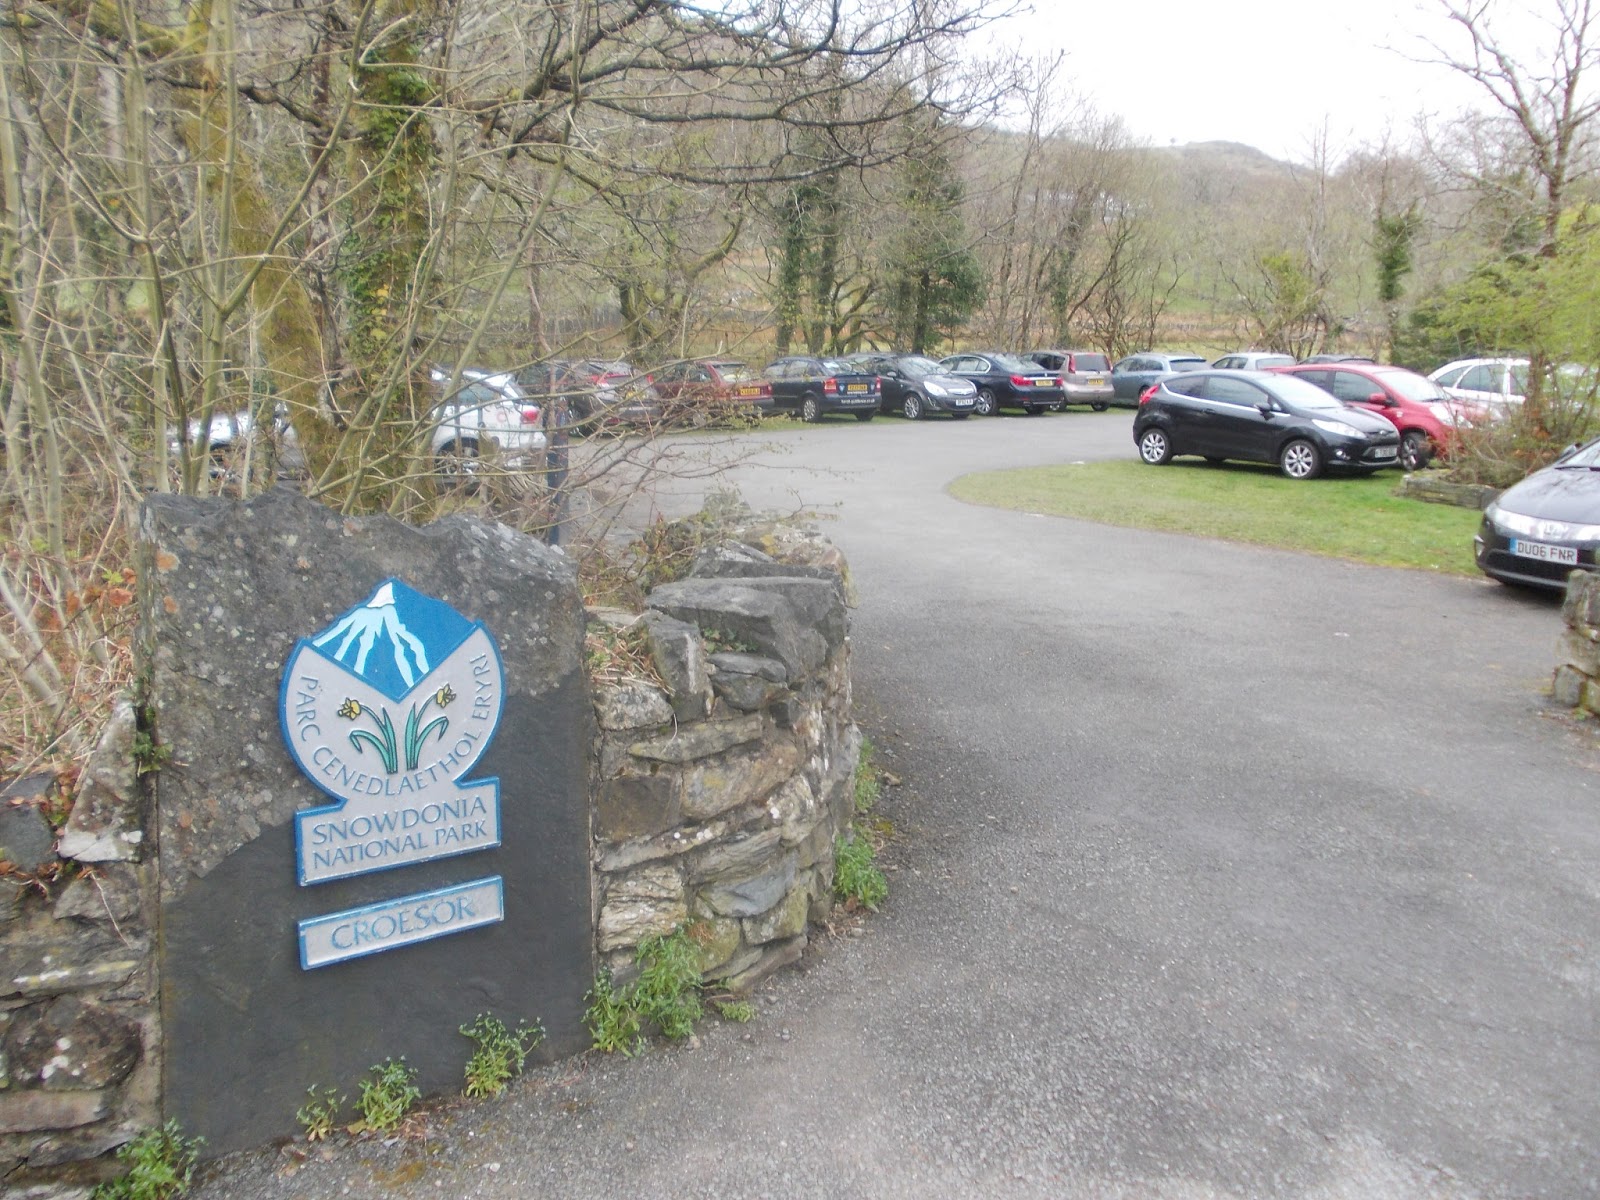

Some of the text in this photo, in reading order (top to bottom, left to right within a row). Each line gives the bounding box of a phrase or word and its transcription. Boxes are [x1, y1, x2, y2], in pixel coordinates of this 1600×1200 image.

[1517, 542, 1575, 562] DU06 FNR
[297, 653, 493, 796] PARC CENEDLAETHOL ERYRI
[312, 796, 487, 845] SNOWDONIA
[313, 819, 487, 869] NATIONAL PARK
[331, 897, 476, 949] CROESOR
